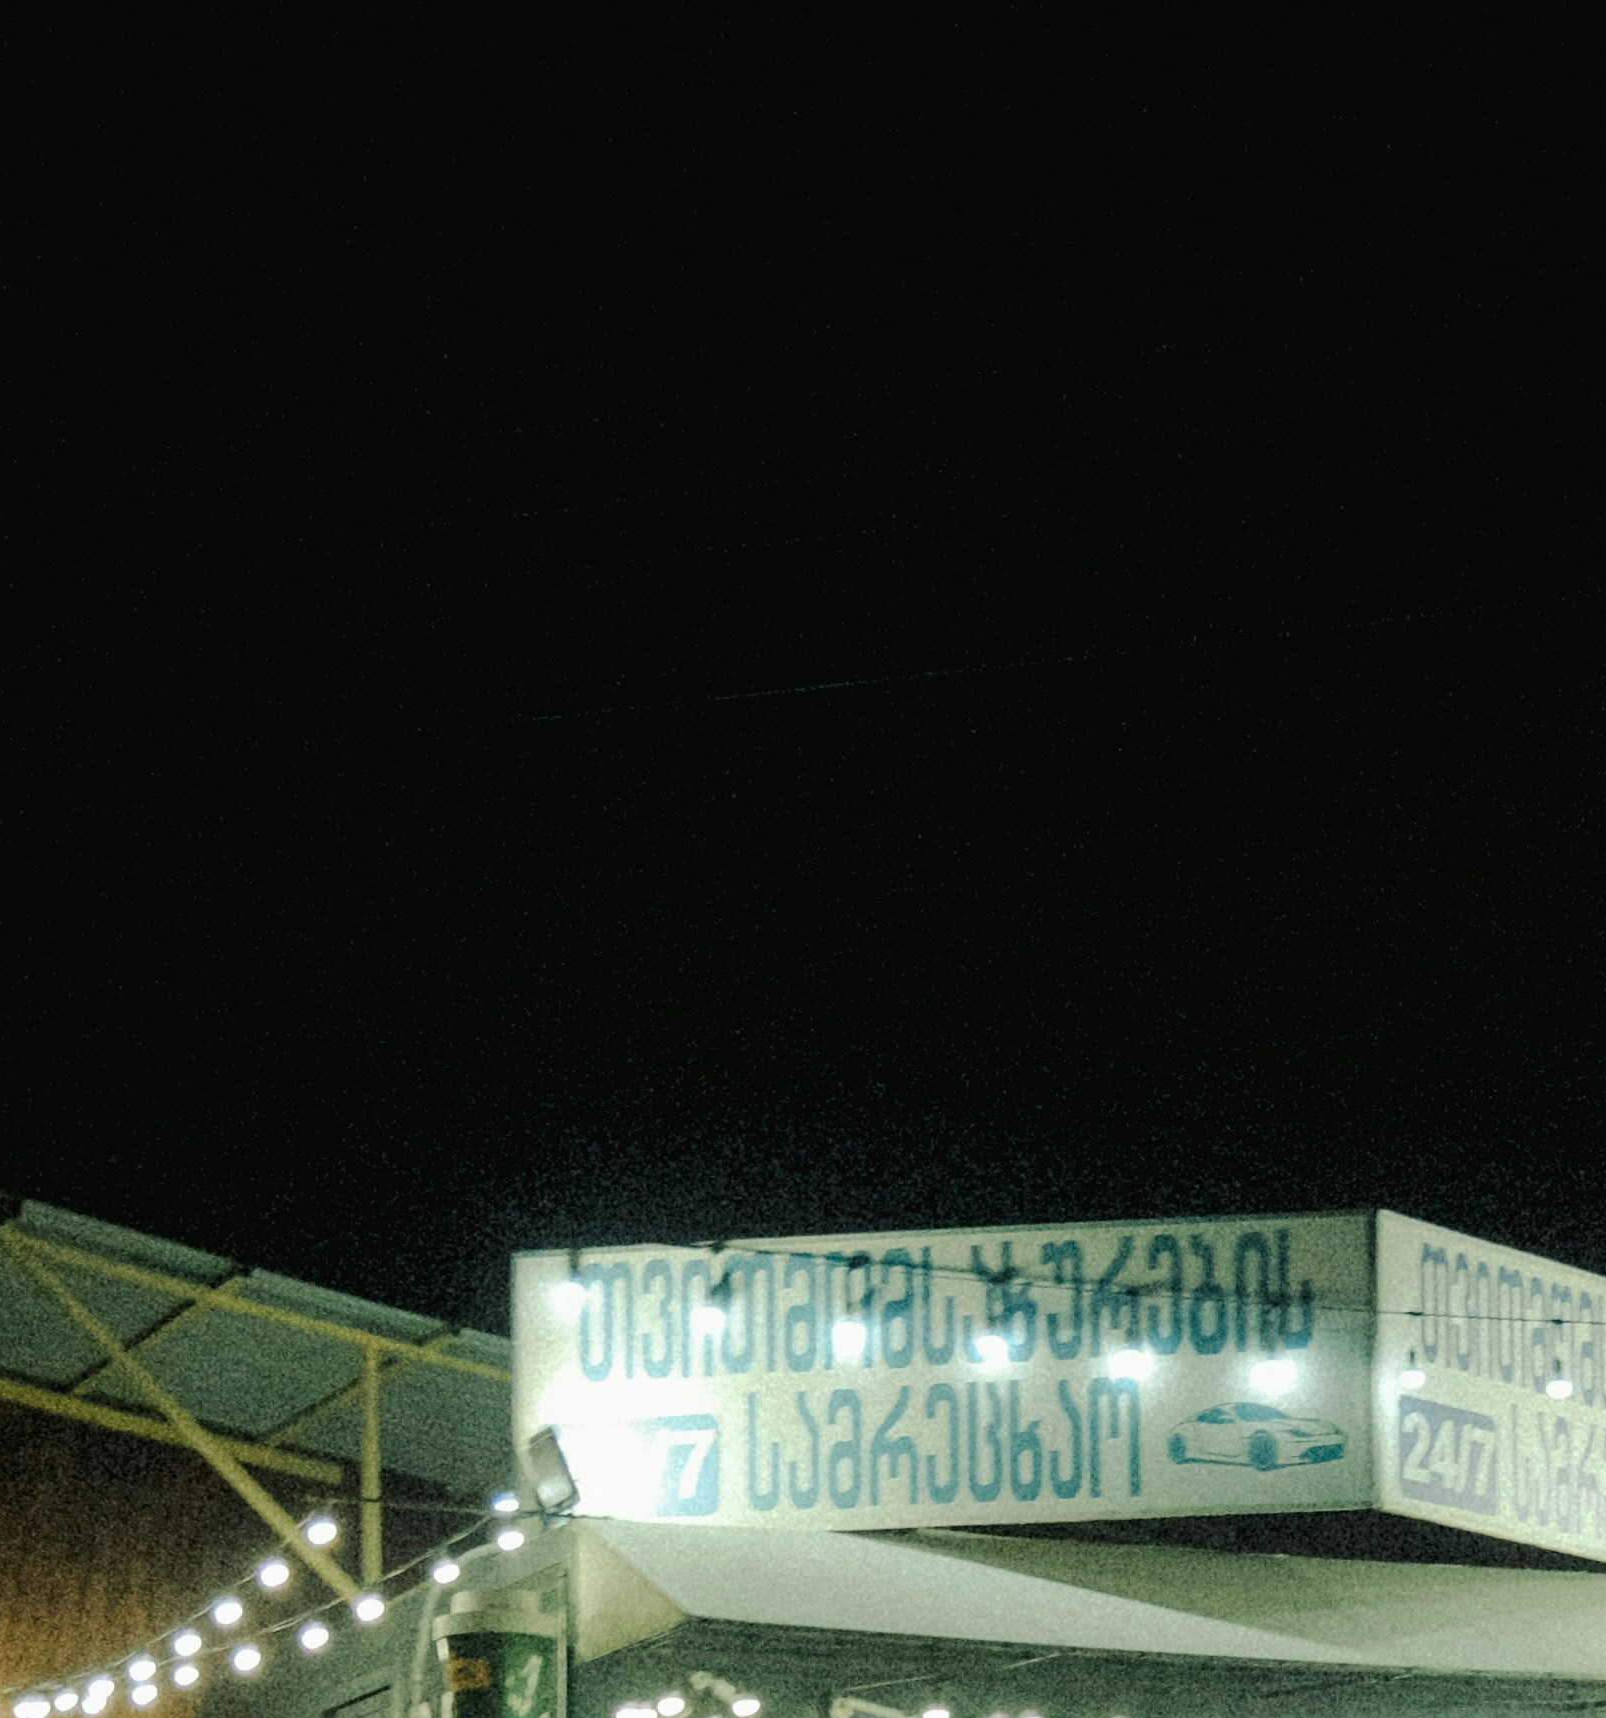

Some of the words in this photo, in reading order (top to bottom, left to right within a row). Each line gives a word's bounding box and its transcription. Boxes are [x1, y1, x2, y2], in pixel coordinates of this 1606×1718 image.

[581, 1232, 1315, 1382] თვითმომსახურების
[748, 1377, 1143, 1513] სამრეცხაო
[1401, 1411, 1496, 1498] 24/7
